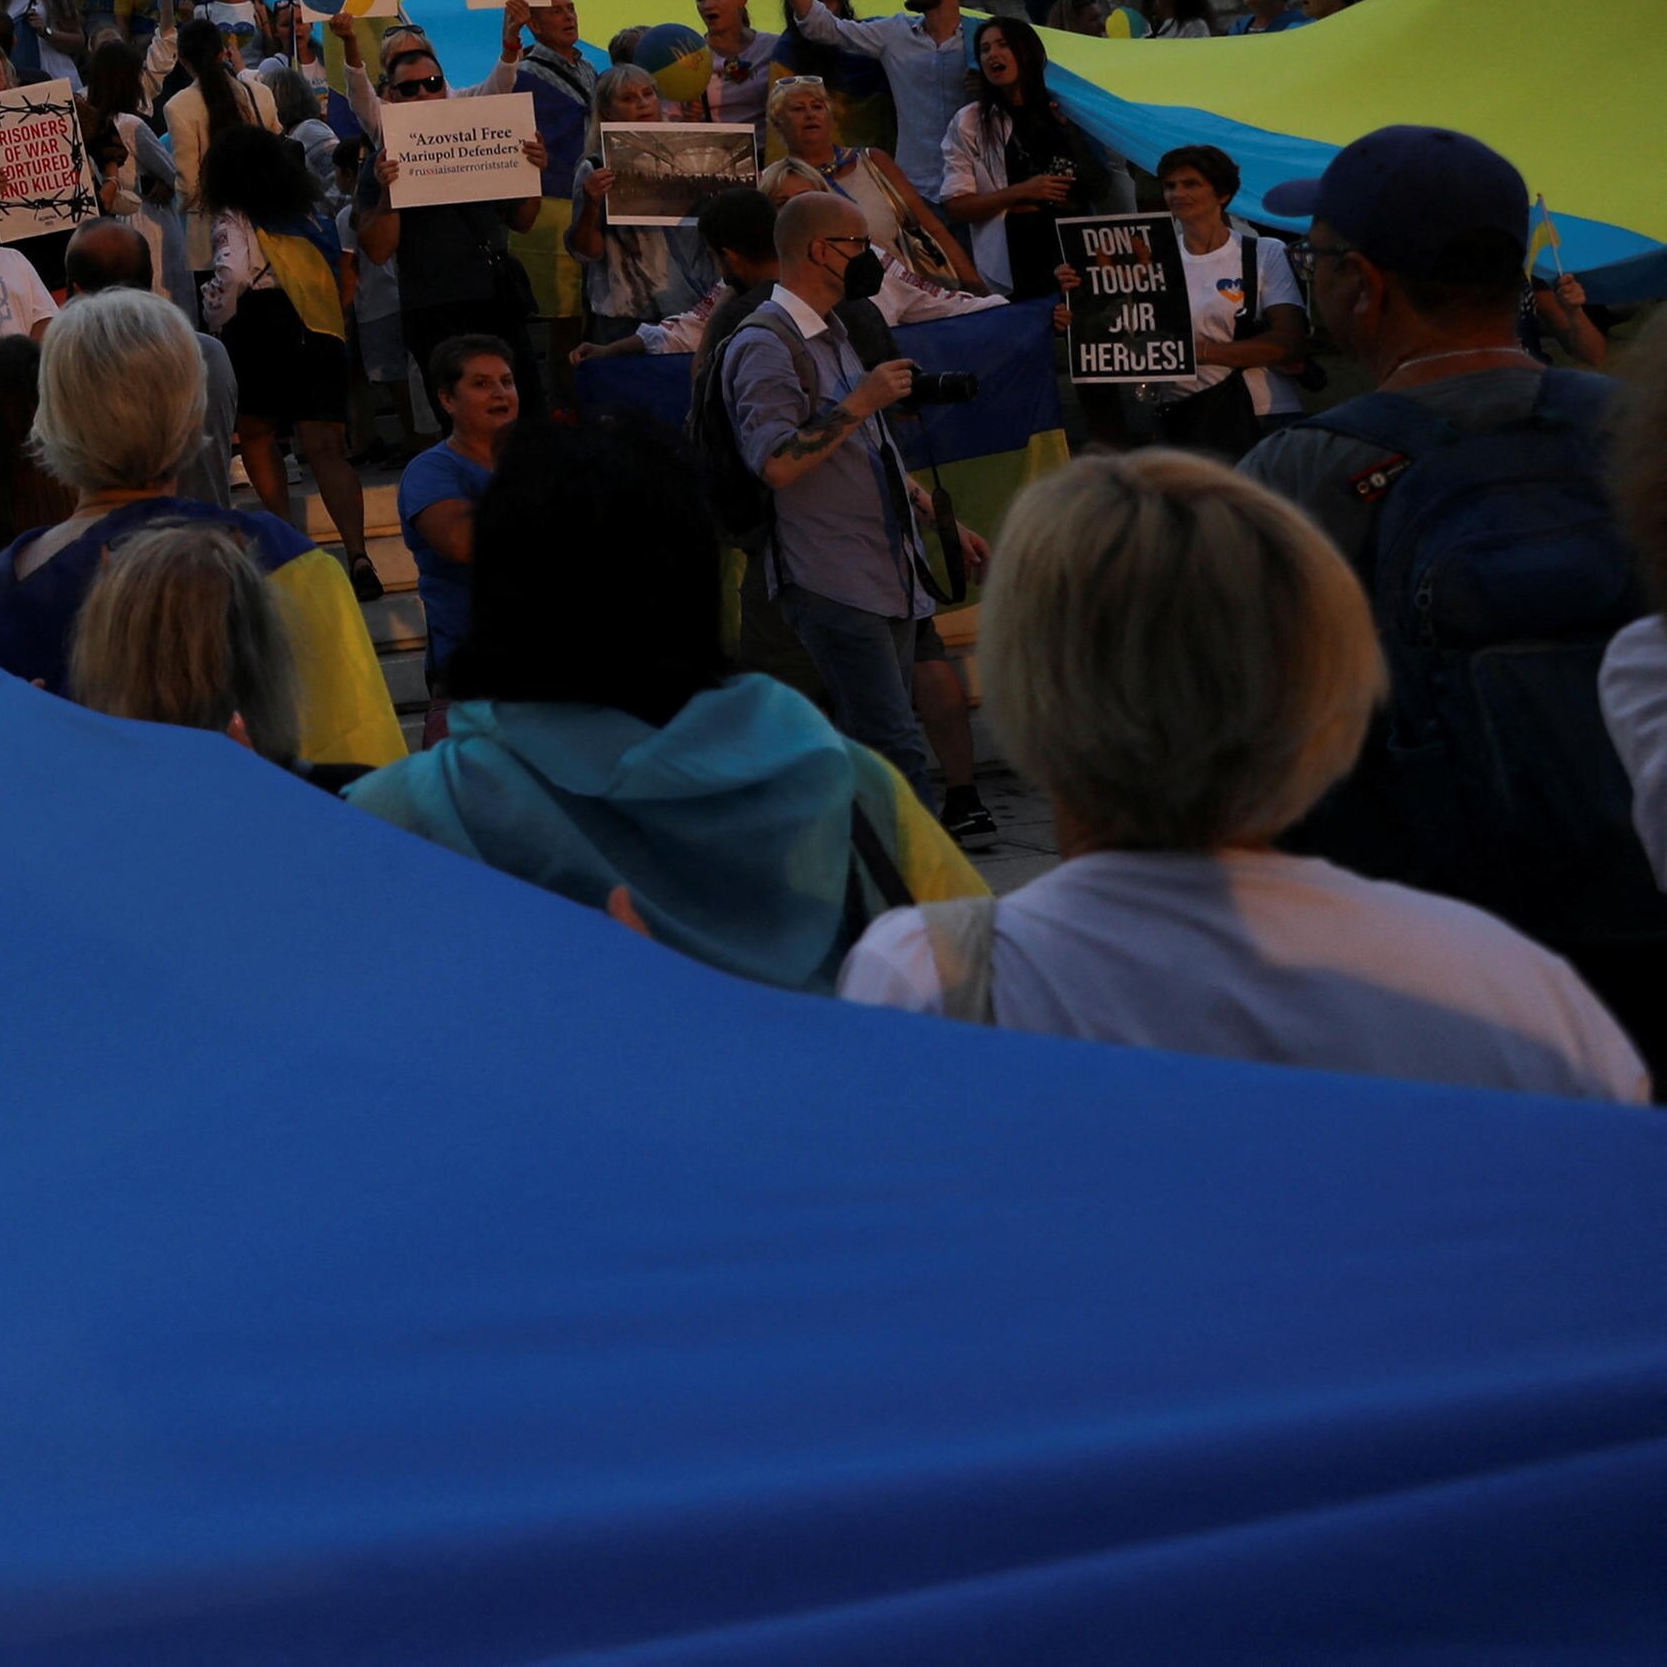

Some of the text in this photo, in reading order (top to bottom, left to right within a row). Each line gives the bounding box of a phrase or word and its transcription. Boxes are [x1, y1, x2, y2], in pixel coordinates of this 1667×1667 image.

[481, 126, 513, 141] Free
[4, 138, 60, 163] OF WAR
[398, 147, 455, 163] Mariupol
[4, 154, 70, 182] ORTURED
[408, 159, 519, 177] #russiaisaterroriststate
[0, 168, 80, 200] AND KILLED
[1081, 225, 1154, 257] DON'T
[1084, 263, 1167, 296] TOUCH
[1079, 340, 1187, 373] HEROES!
